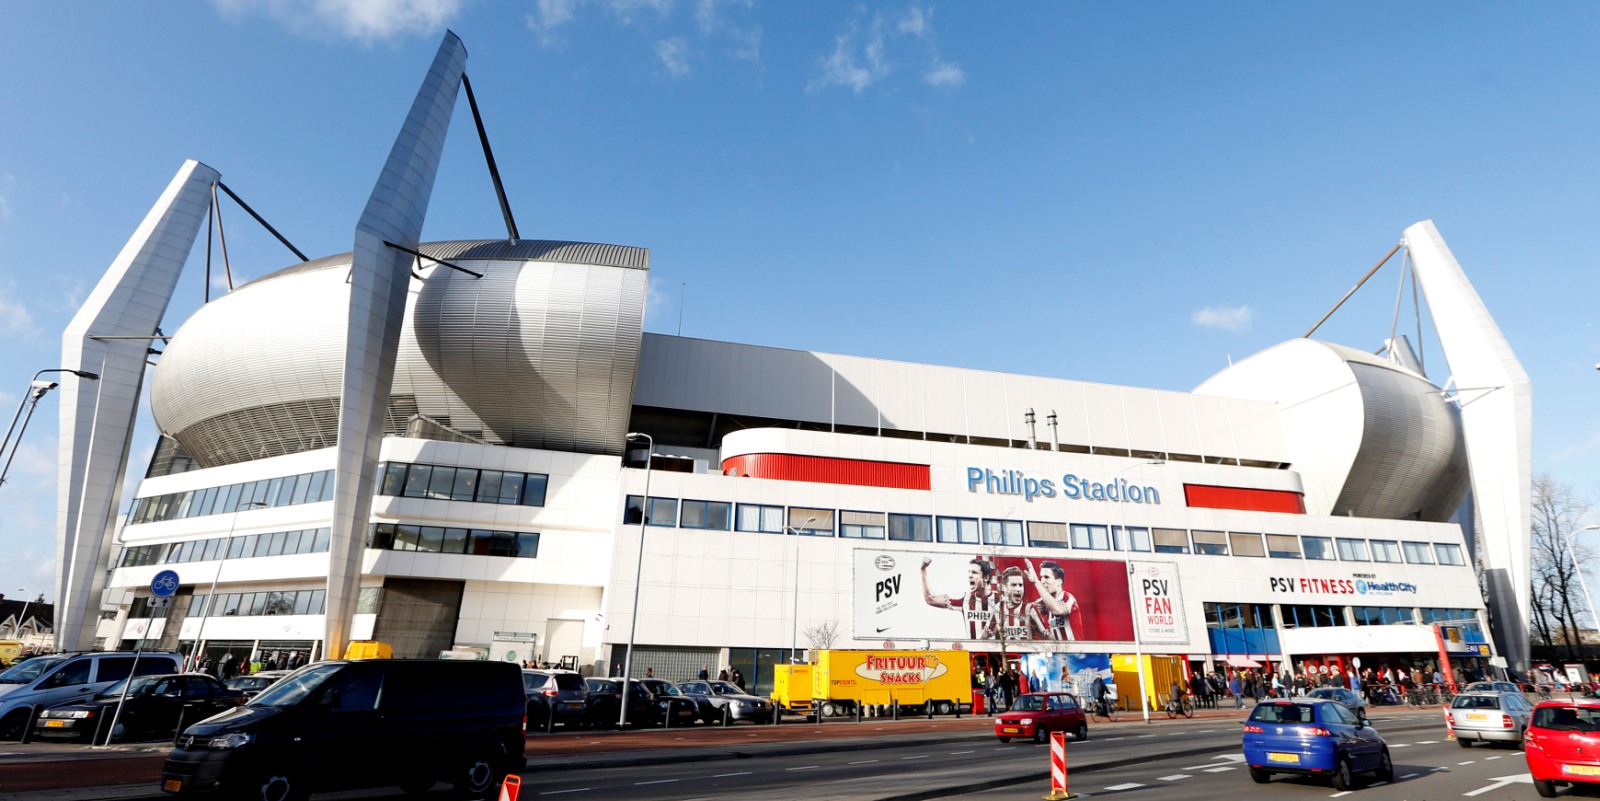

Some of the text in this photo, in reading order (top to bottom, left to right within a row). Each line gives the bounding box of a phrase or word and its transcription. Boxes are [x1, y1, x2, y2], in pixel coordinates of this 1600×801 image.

[967, 467, 1160, 504] Philips Stadion
[876, 573, 901, 602] PSV
[1142, 579, 1167, 596] PSV
[1270, 577, 1416, 594] PSV FITNESS HealthCity
[1145, 597, 1172, 614] FAN
[1147, 616, 1174, 625] WORLD
[866, 655, 925, 670] FRITUUR
[881, 671, 921, 684] SNACKS
